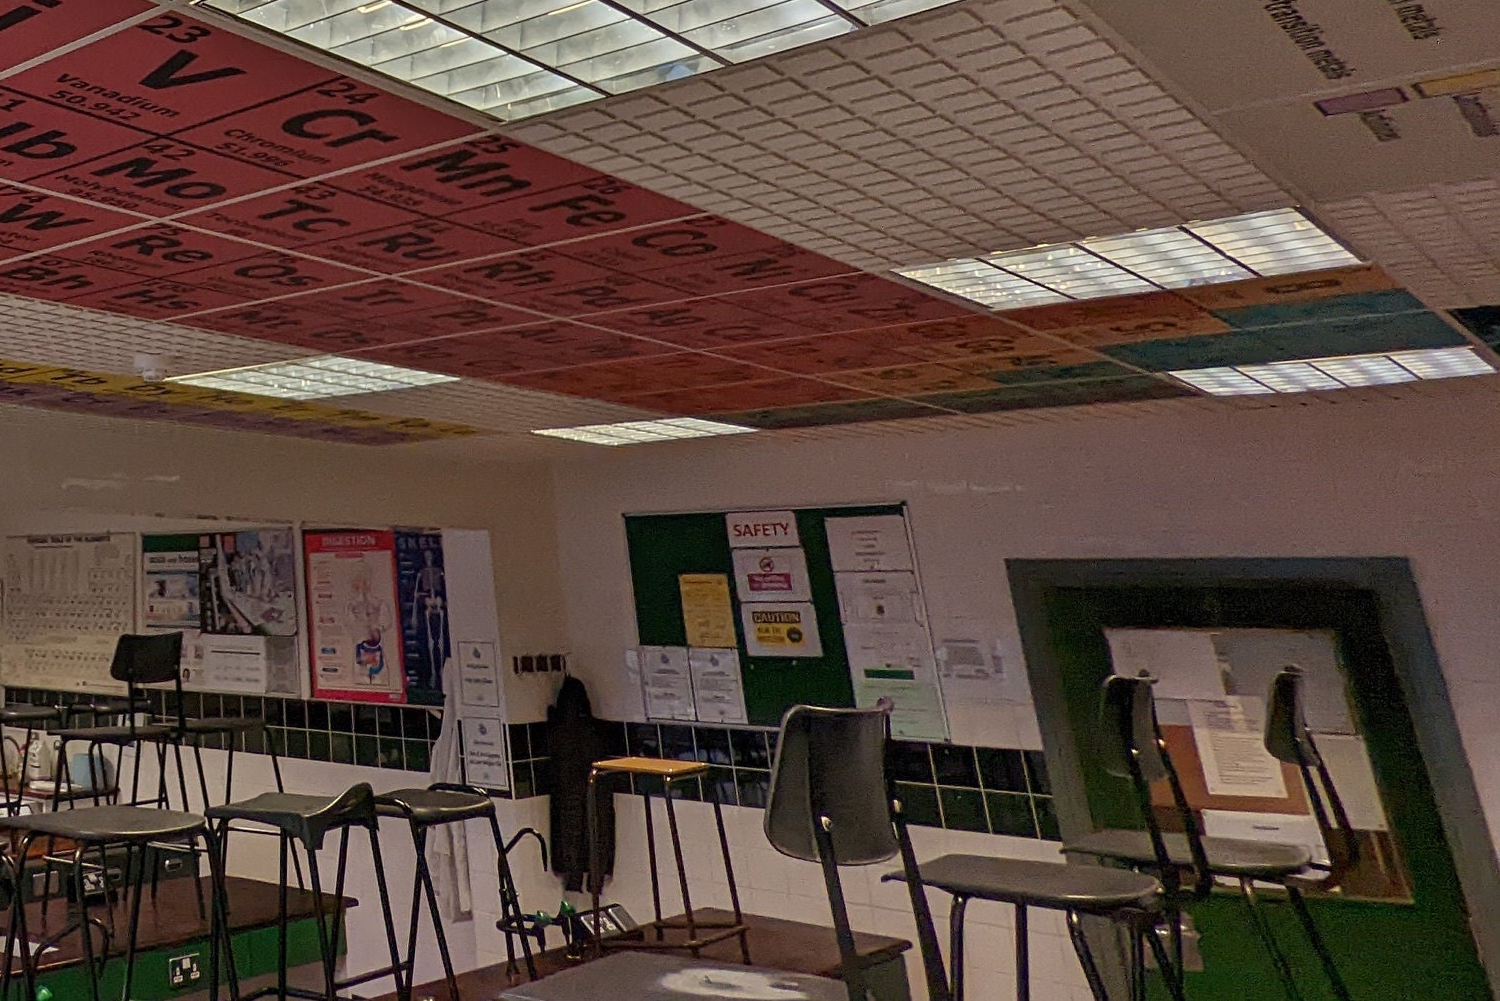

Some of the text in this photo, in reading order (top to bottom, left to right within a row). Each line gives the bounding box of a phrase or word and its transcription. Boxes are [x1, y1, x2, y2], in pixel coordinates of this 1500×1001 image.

[137, 14, 212, 44] 23
[138, 49, 248, 90] V
[48, 90, 142, 121] 50.942
[56, 72, 181, 119] Vanadium
[315, 82, 380, 105] 24
[282, 108, 400, 148] Cr
[224, 128, 332, 165] Chromium
[90, 157, 227, 199] Mo
[400, 149, 533, 198] Mn
[257, 198, 351, 233] Tc
[528, 194, 627, 227] Fe
[110, 234, 214, 264] Re
[357, 232, 461, 260] Ru
[631, 229, 718, 257] Co
[234, 264, 324, 286] Os
[463, 260, 555, 287] Rh
[732, 522, 789, 537] SAFETY
[753, 612, 800, 623] CAUTION
